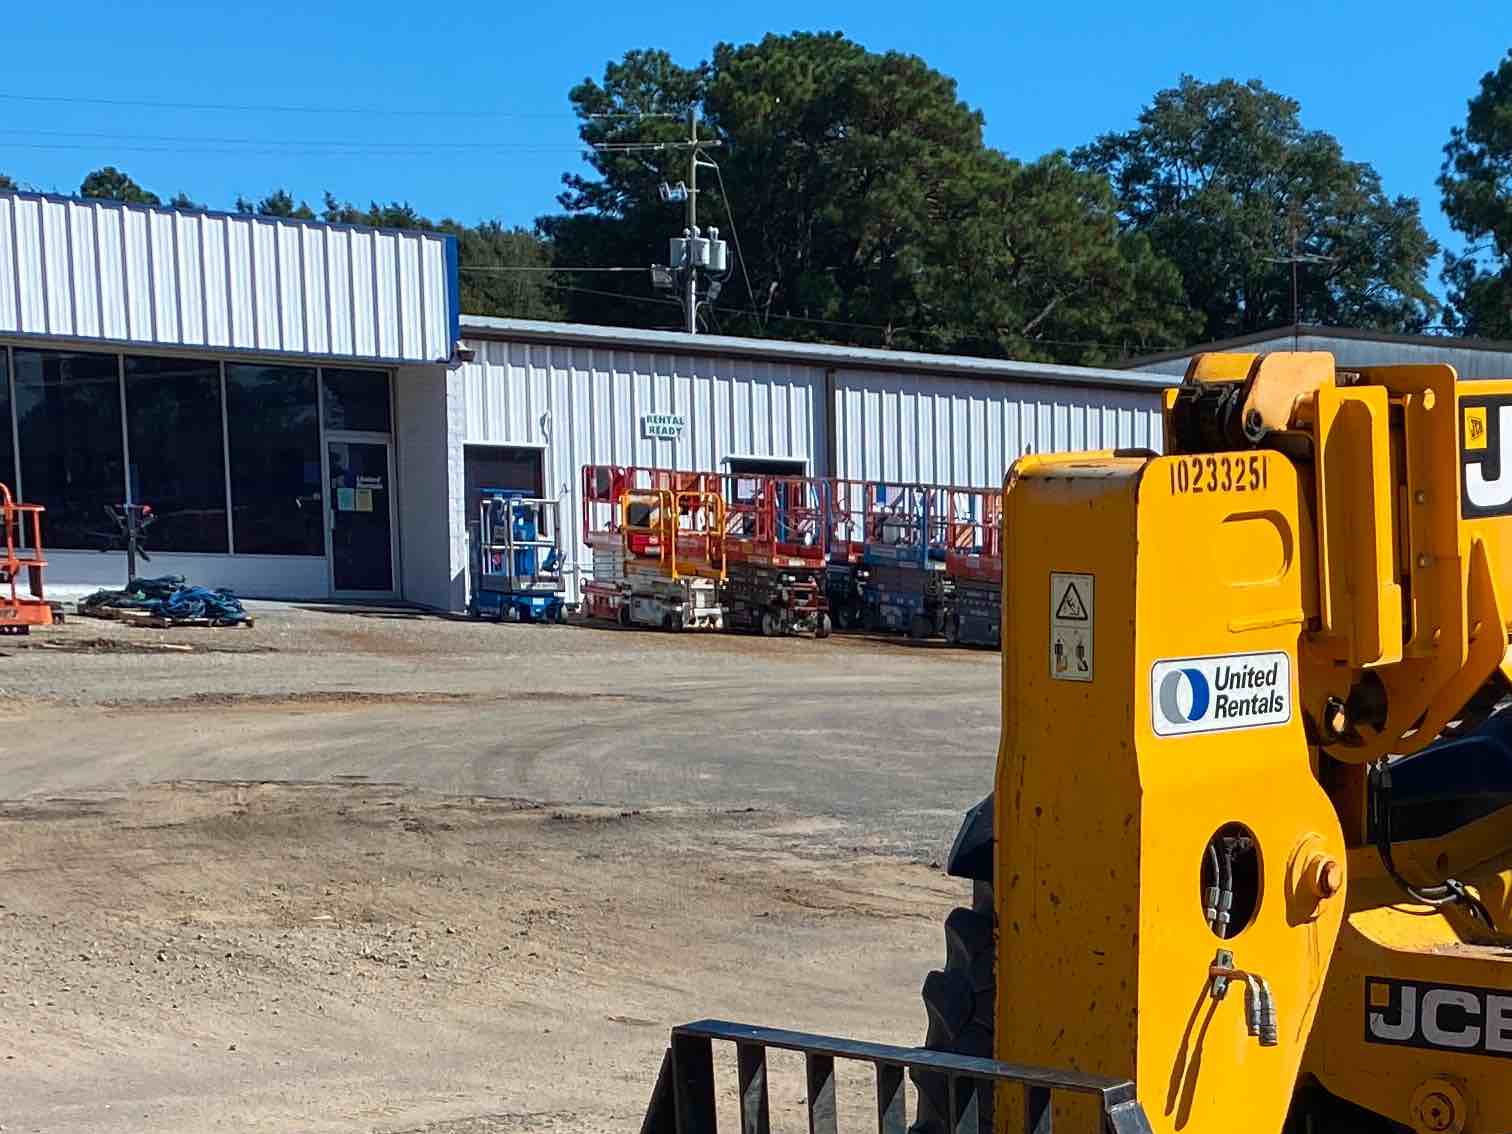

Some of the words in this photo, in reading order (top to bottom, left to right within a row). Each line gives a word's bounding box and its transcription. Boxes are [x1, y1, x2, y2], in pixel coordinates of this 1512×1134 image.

[647, 415, 685, 425] RENTAL
[649, 426, 682, 436] READY
[1170, 456, 1267, 495] 10233251
[1214, 662, 1278, 691] United
[1214, 689, 1284, 719] Rentals
